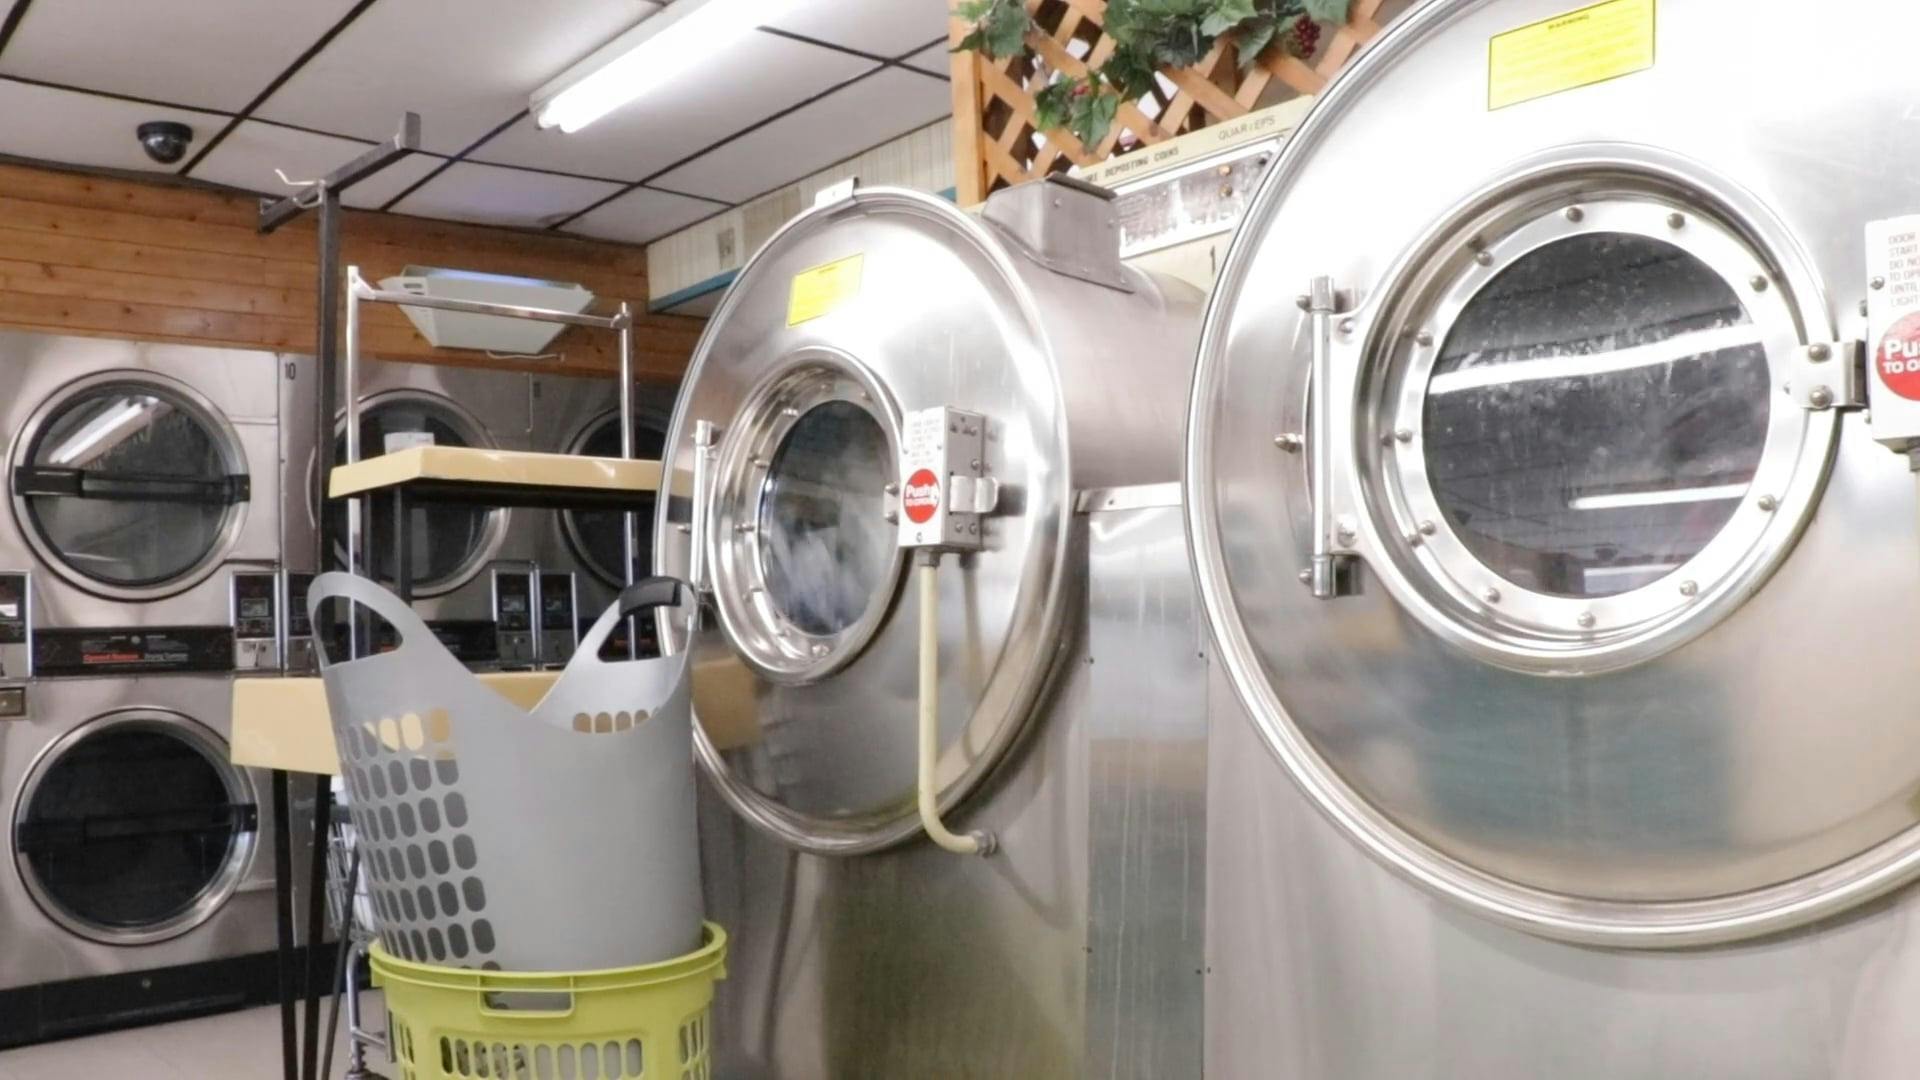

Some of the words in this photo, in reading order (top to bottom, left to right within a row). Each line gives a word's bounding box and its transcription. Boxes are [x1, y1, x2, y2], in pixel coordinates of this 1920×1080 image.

[1884, 339, 1920, 361] Pu
[284, 362, 297, 380] 10
[1882, 359, 1905, 374] TO
[1906, 358, 1920, 373] O
